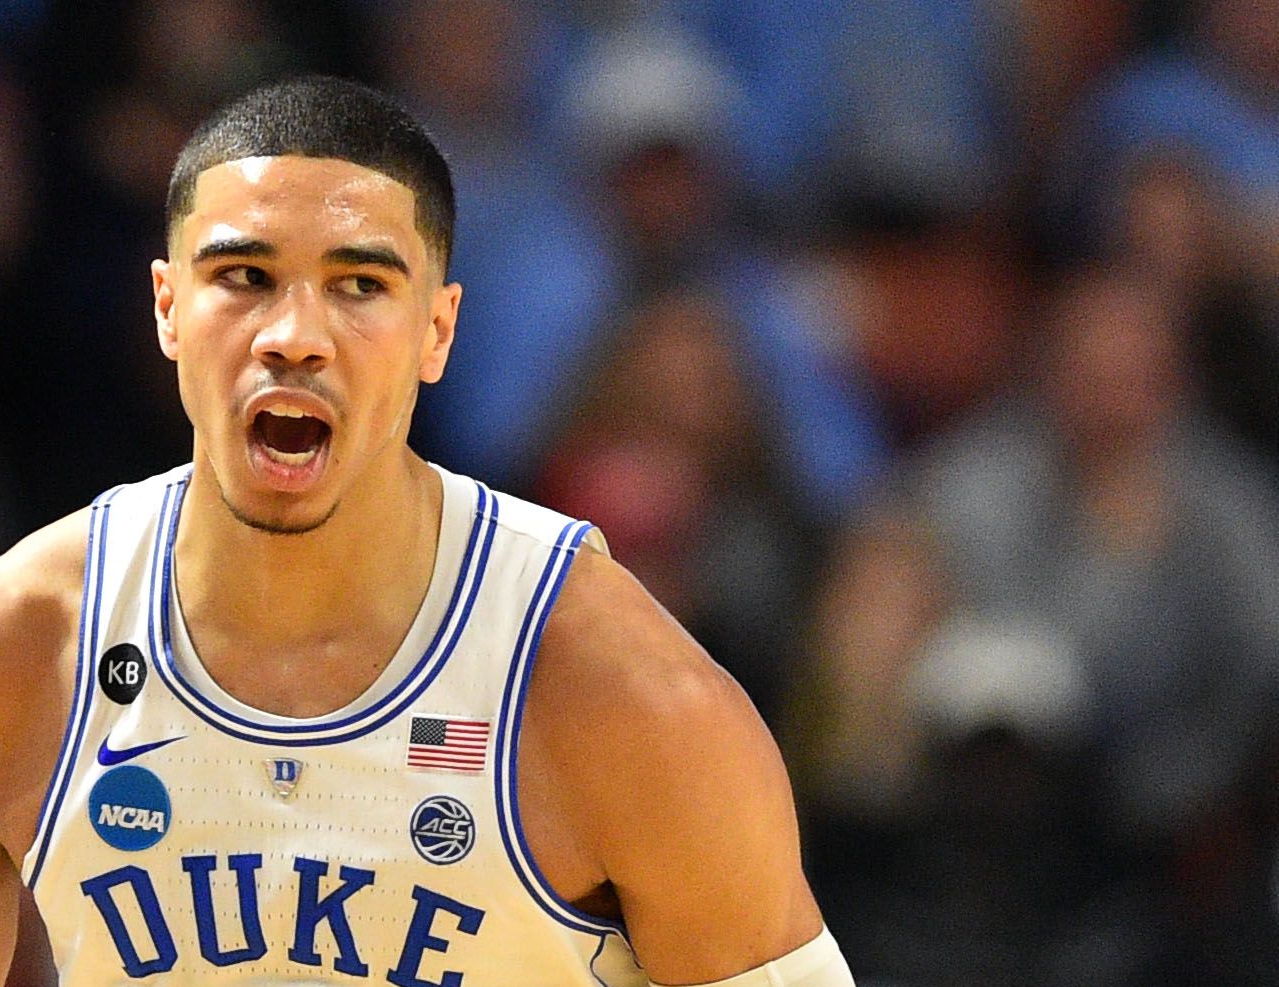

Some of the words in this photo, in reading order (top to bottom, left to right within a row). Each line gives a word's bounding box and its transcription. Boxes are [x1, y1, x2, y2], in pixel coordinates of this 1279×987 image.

[108, 660, 139, 685] KB
[274, 761, 295, 781] D
[98, 804, 164, 833] NCAA
[420, 817, 471, 836] ACC
